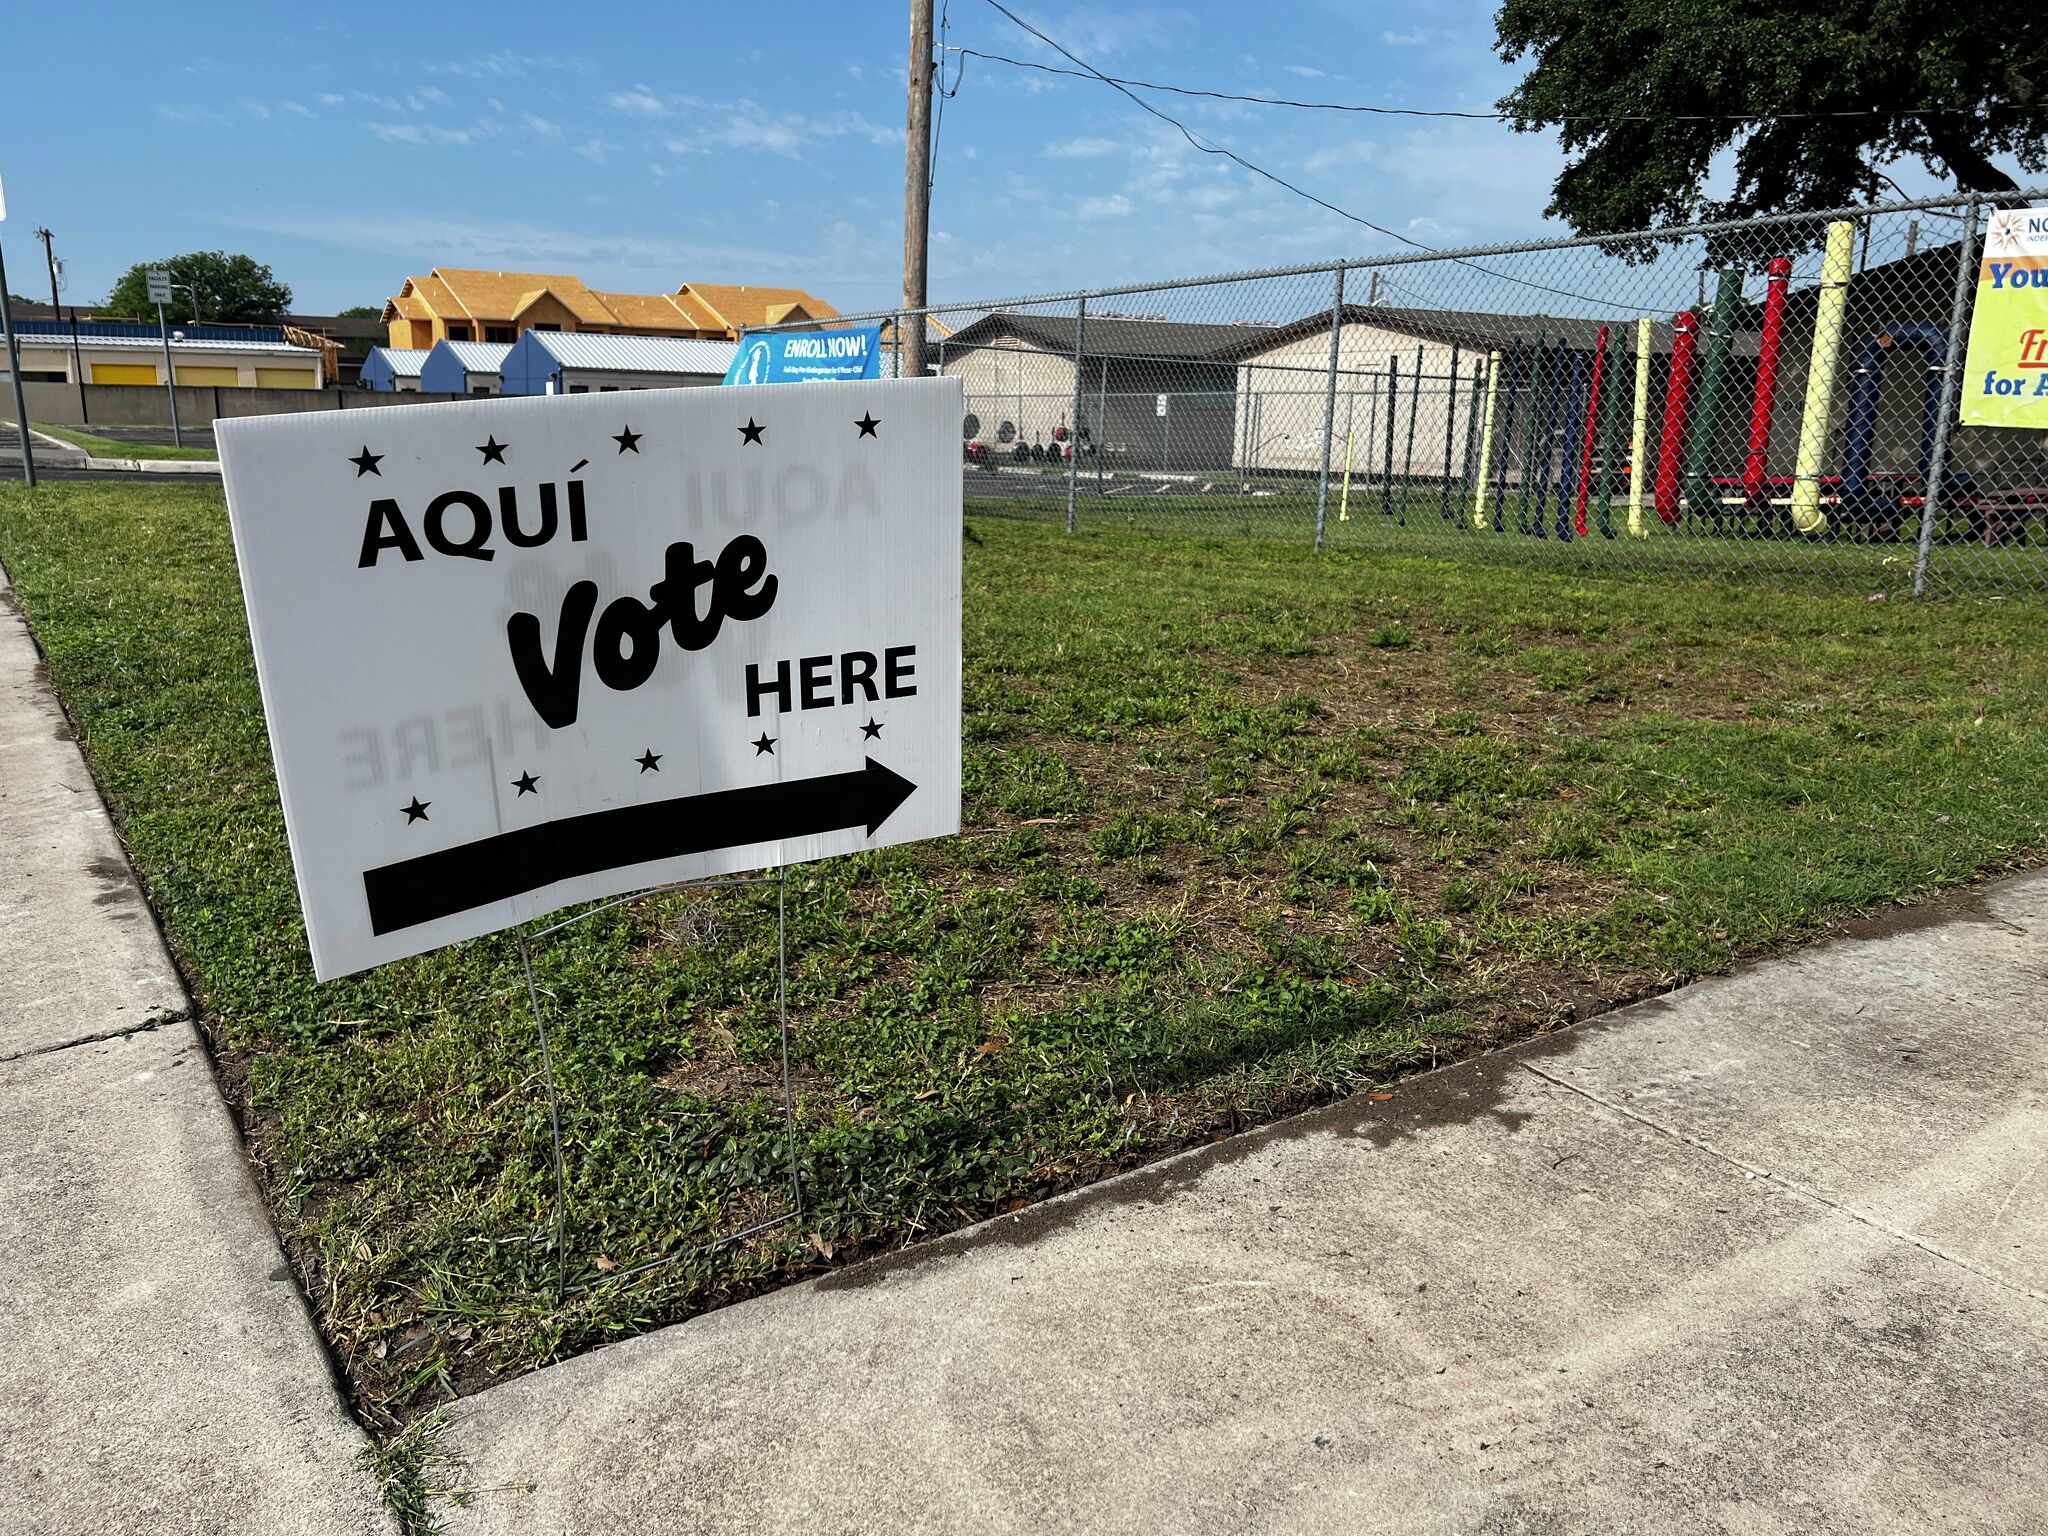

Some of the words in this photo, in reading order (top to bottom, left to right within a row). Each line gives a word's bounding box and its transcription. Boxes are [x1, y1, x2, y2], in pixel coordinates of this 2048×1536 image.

[1989, 263, 2048, 288] You
[784, 338, 827, 358] ENROLL
[827, 334, 867, 357] NOW!
[1983, 370, 2026, 396] for
[358, 459, 589, 569] AQUÍ
[507, 534, 779, 729] Vote
[746, 644, 917, 717] HERE
